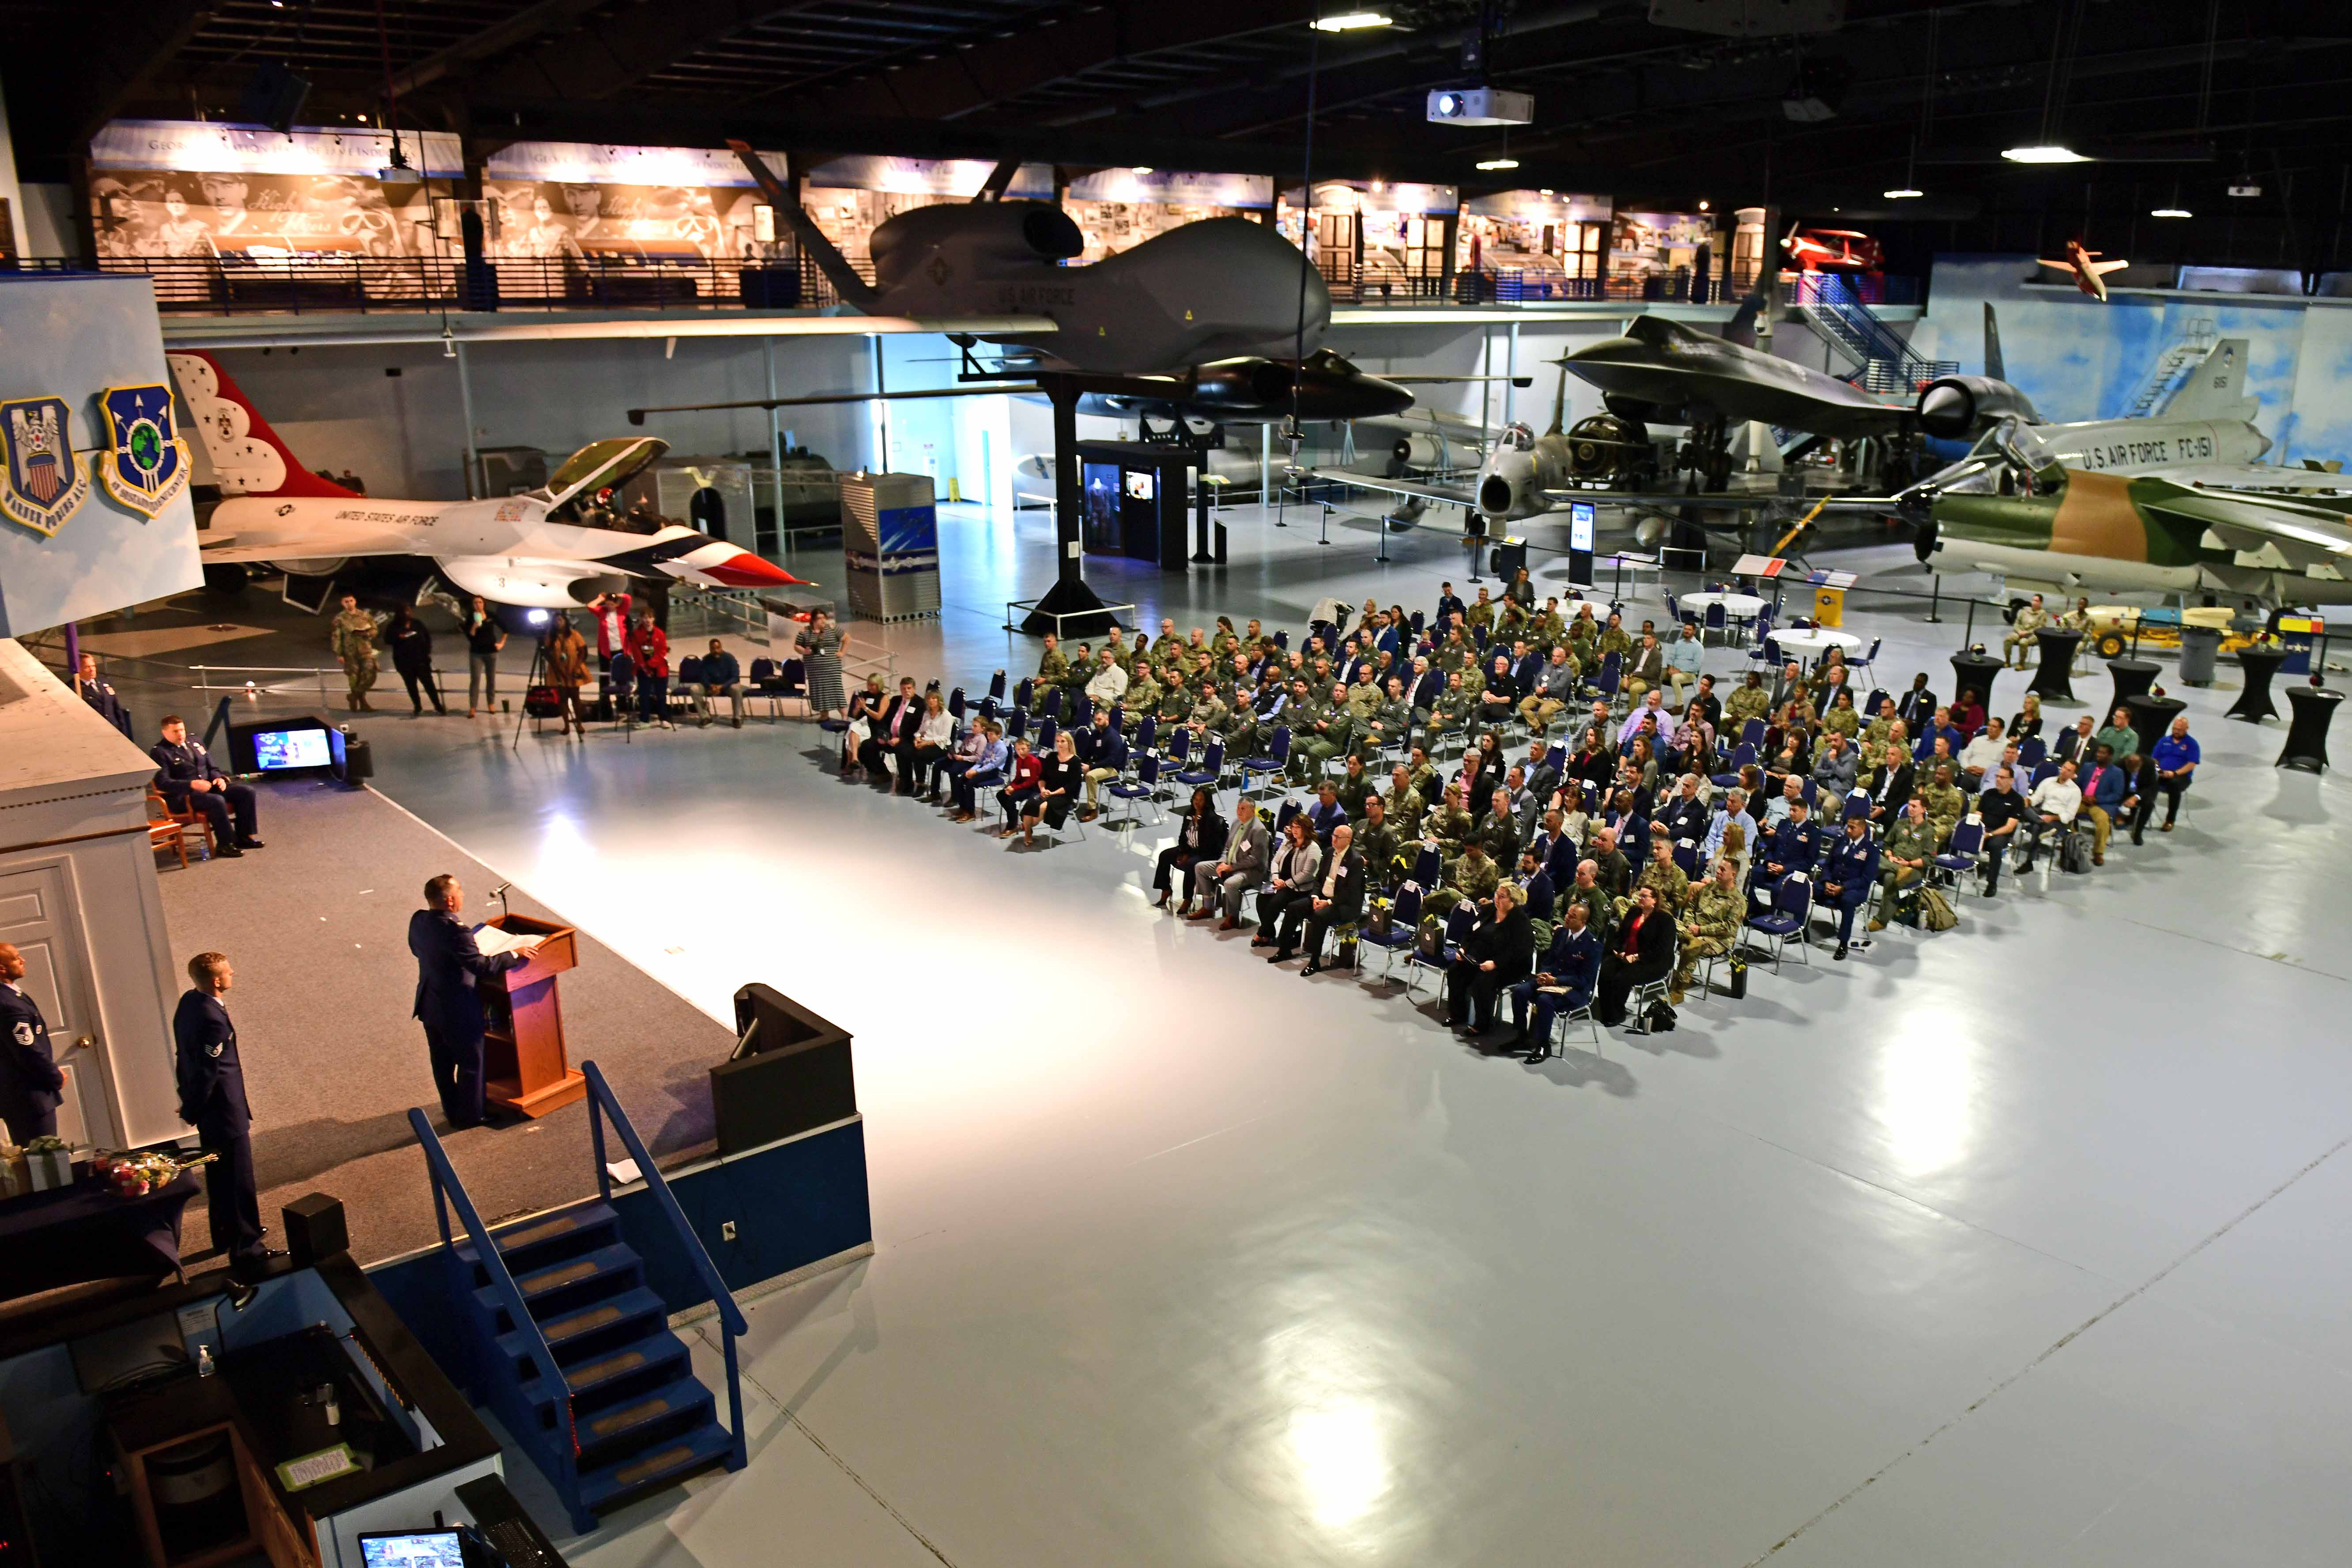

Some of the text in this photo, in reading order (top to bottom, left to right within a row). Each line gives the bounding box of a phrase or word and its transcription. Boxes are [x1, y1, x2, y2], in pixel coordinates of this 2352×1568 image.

[2108, 445, 2129, 467] AIR
[2129, 441, 2168, 464] FORCE
[2177, 436, 2213, 460] FC-151
[4, 489, 42, 524] WARNER
[335, 510, 440, 527] UNITED STATES AIR FORCE
